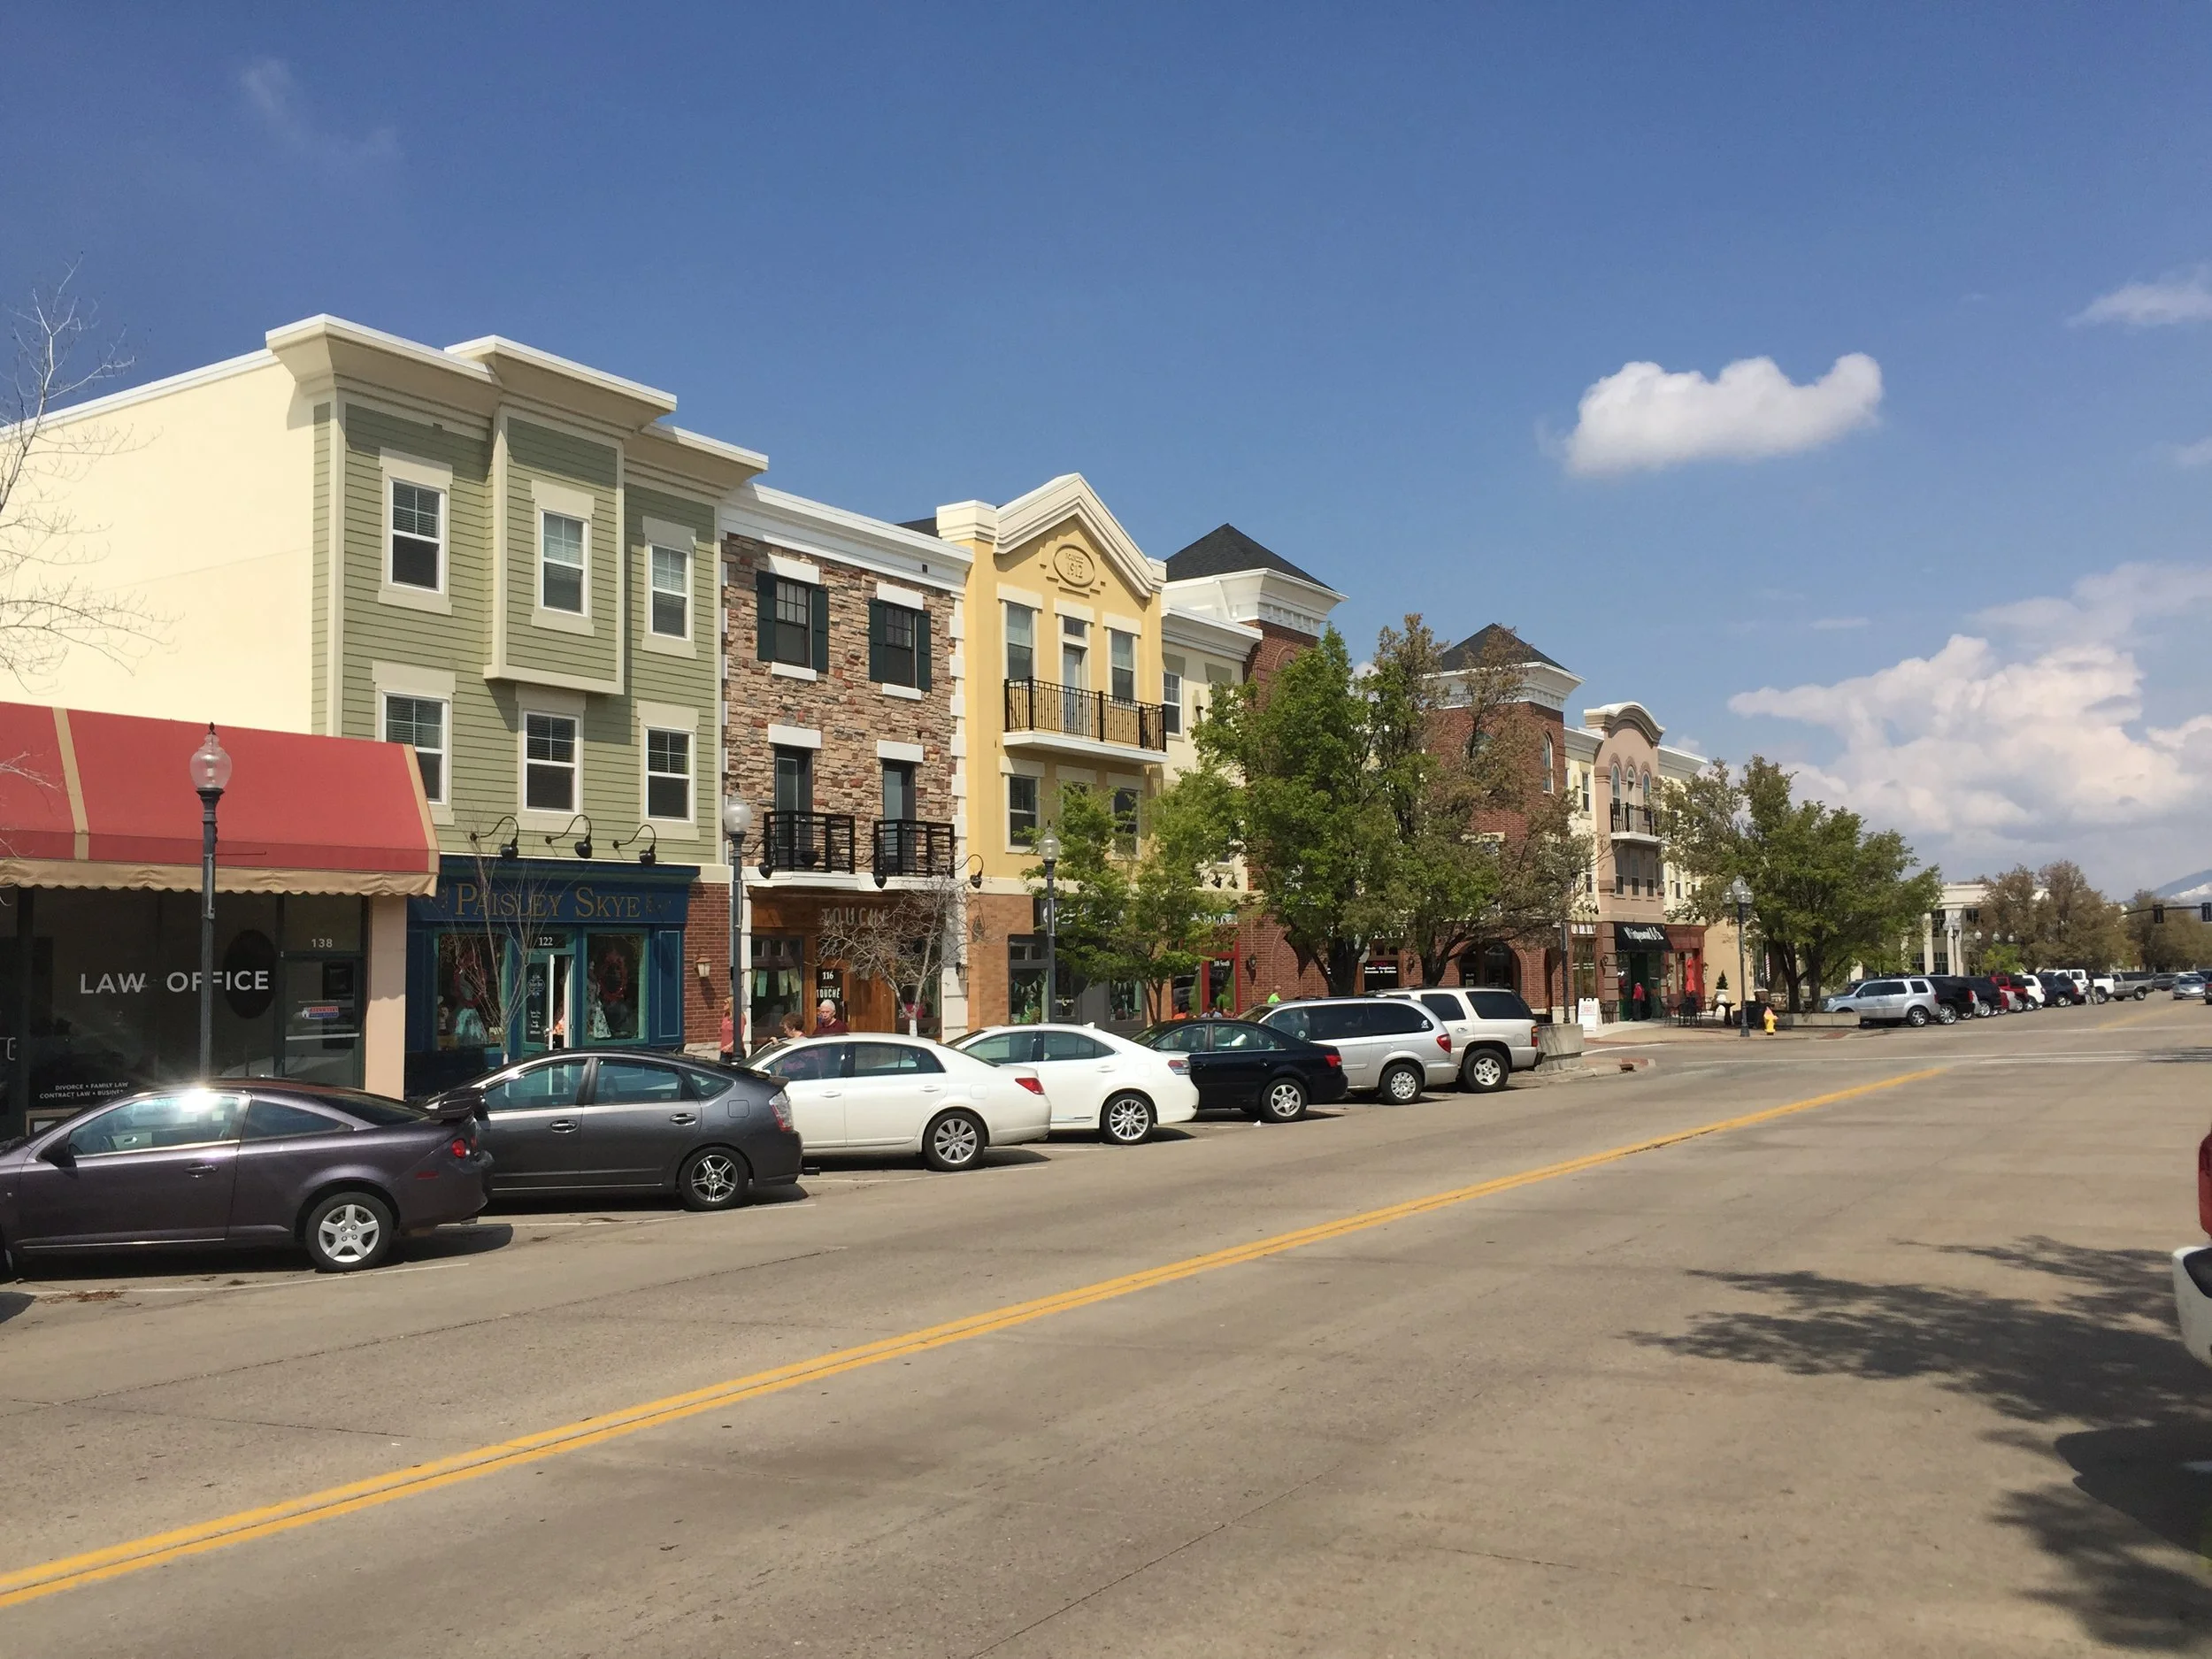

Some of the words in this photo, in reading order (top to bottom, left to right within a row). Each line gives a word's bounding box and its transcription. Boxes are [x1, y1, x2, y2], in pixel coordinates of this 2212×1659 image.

[455, 883, 563, 917] PAISLEY
[575, 887, 641, 918] SKYE
[311, 938, 334, 948] 138
[538, 936, 553, 946] 122
[822, 971, 834, 980] 116
[81, 972, 146, 995] LAW
